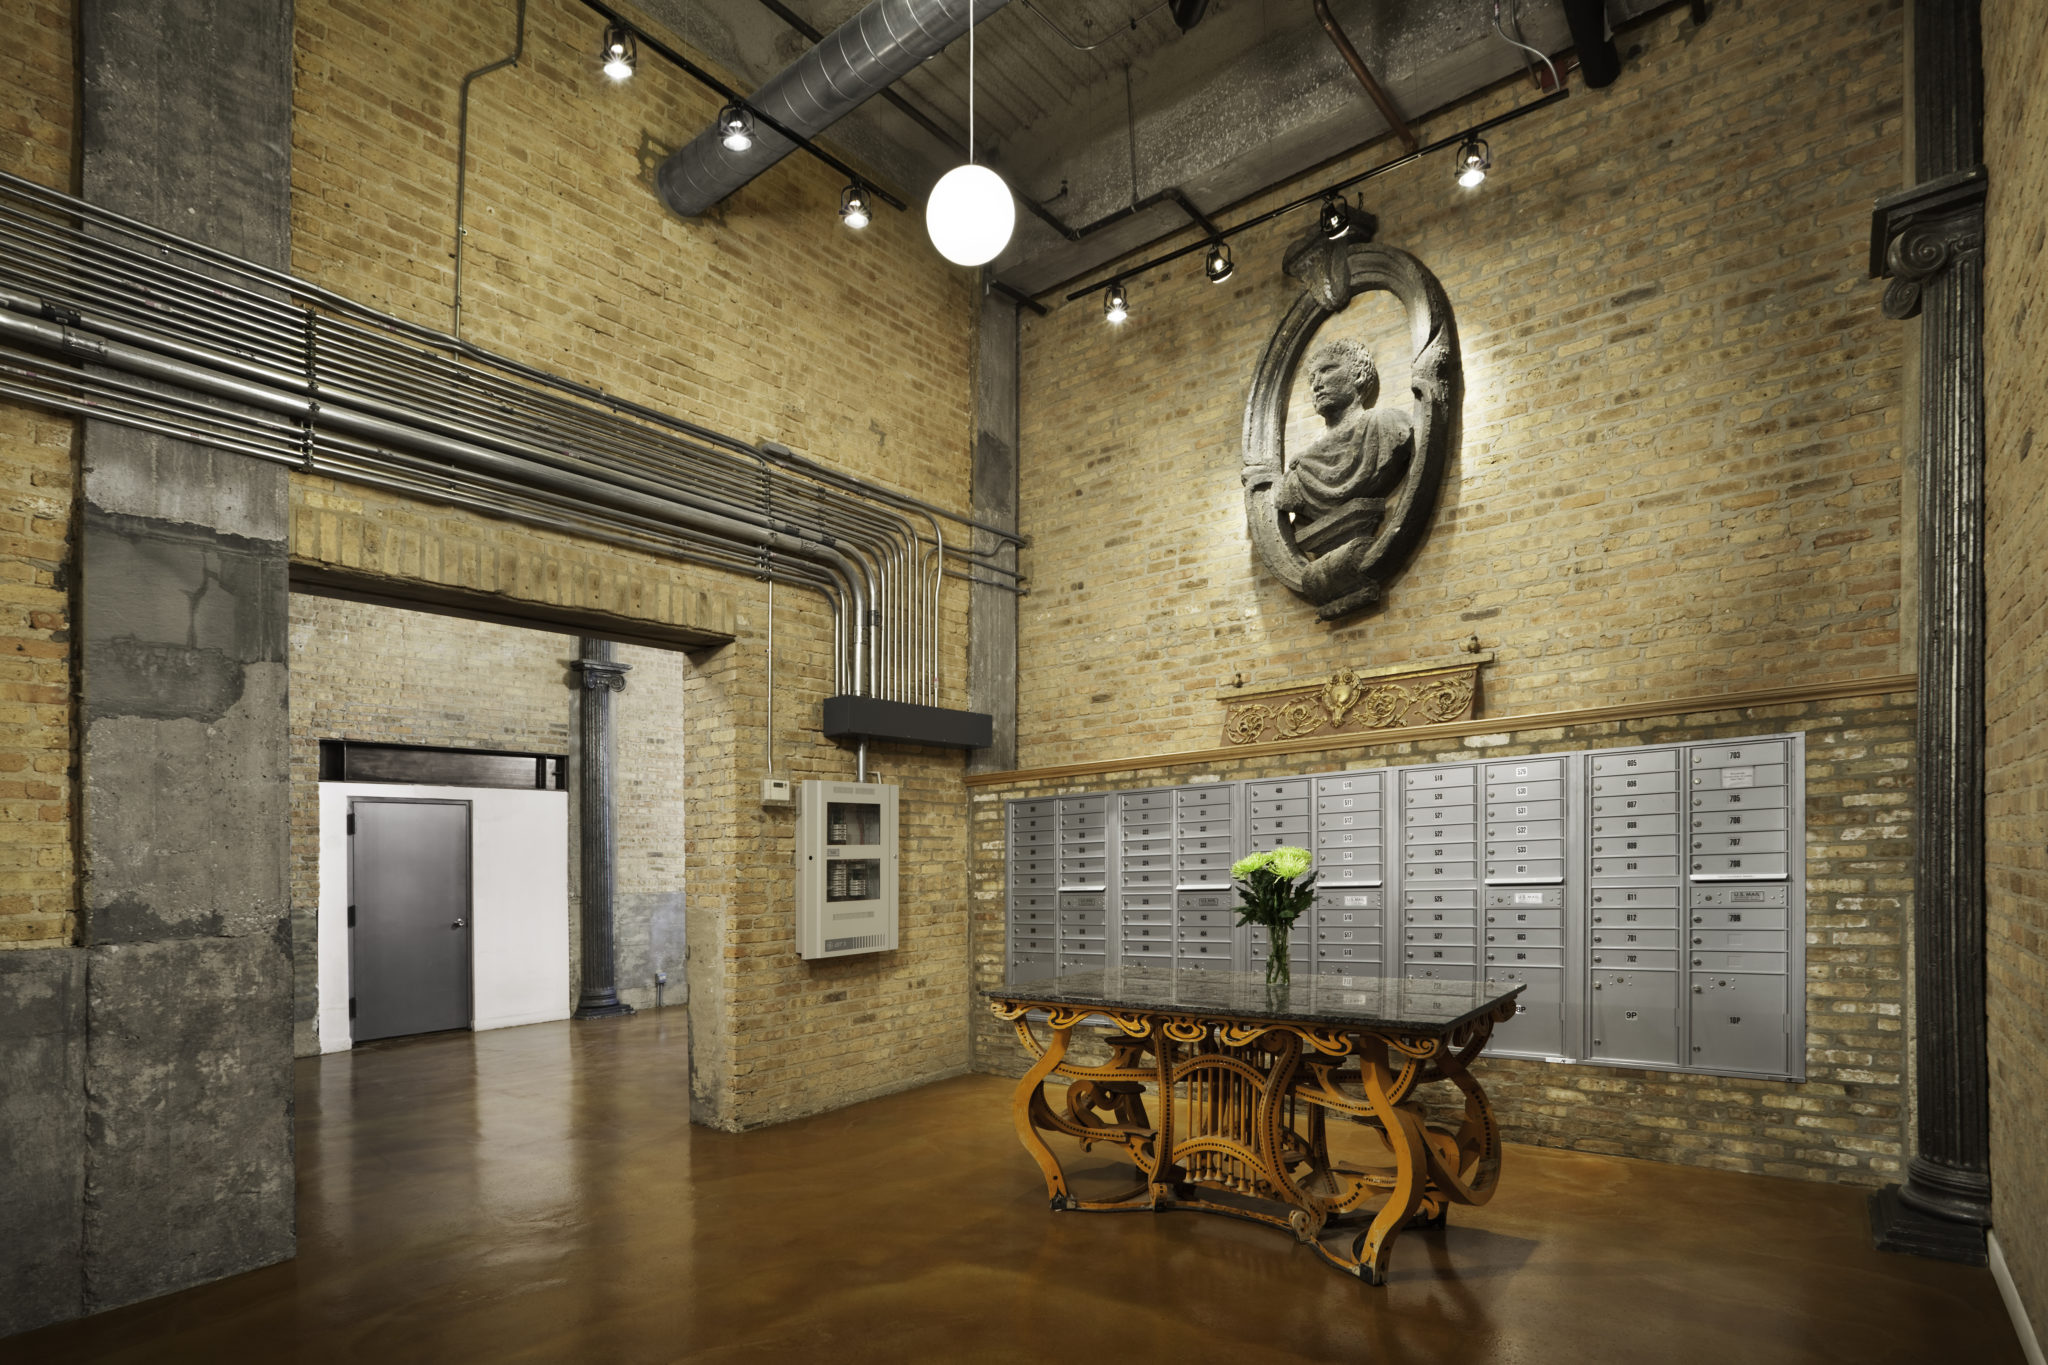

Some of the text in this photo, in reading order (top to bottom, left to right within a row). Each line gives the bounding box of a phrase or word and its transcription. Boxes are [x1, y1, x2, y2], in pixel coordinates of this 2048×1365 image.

[1729, 751, 1741, 759] 703
[1729, 794, 1741, 803] 705
[1434, 811, 1443, 819] 521
[1517, 807, 1527, 815] 531
[1434, 830, 1443, 838] 522
[1517, 826, 1527, 834] 532
[1344, 834, 1353, 842] 513
[1729, 838, 1741, 846] 707
[1517, 846, 1527, 854] 533
[1344, 869, 1353, 877] 515
[1434, 867, 1443, 875] 524
[1434, 895, 1443, 903] 525
[1344, 931, 1353, 939] 517
[1434, 932, 1443, 940] 527
[1626, 934, 1637, 942] 701
[1626, 955, 1637, 963] 702
[1625, 1011, 1638, 1019] 9P
